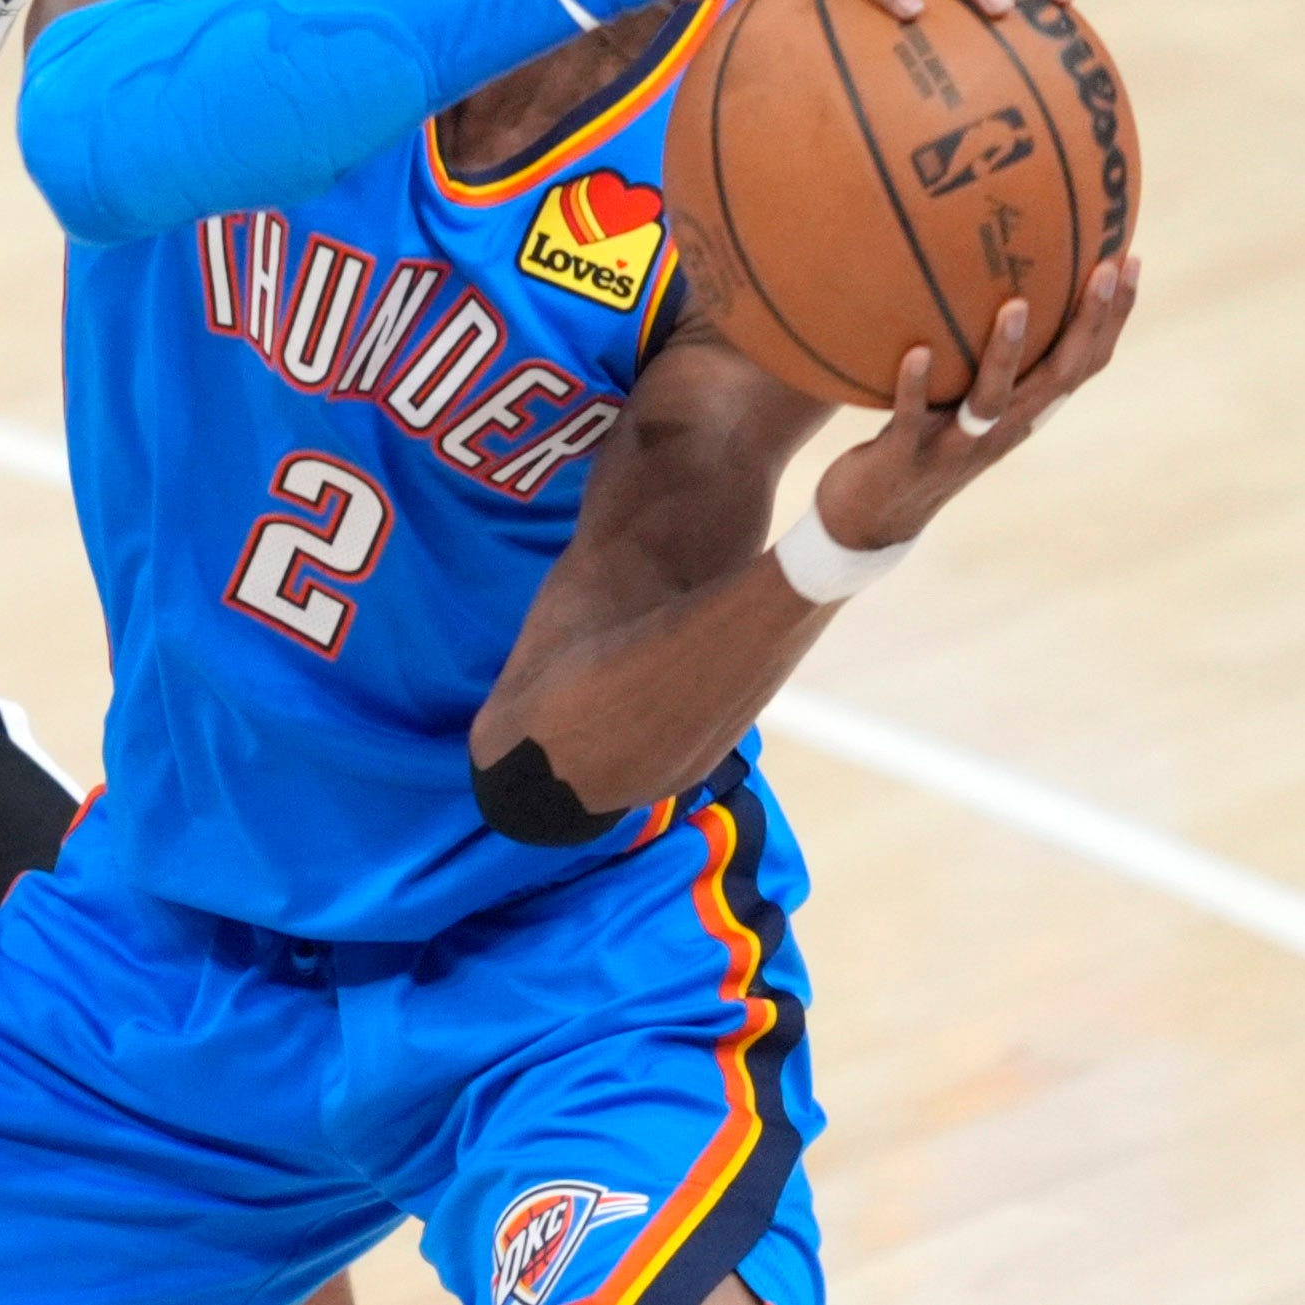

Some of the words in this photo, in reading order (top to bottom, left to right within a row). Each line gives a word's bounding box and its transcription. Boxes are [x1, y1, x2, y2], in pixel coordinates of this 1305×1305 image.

[197, 207, 629, 501] THUNDER
[222, 448, 393, 664] 2
[496, 1199, 570, 1305] OKC
